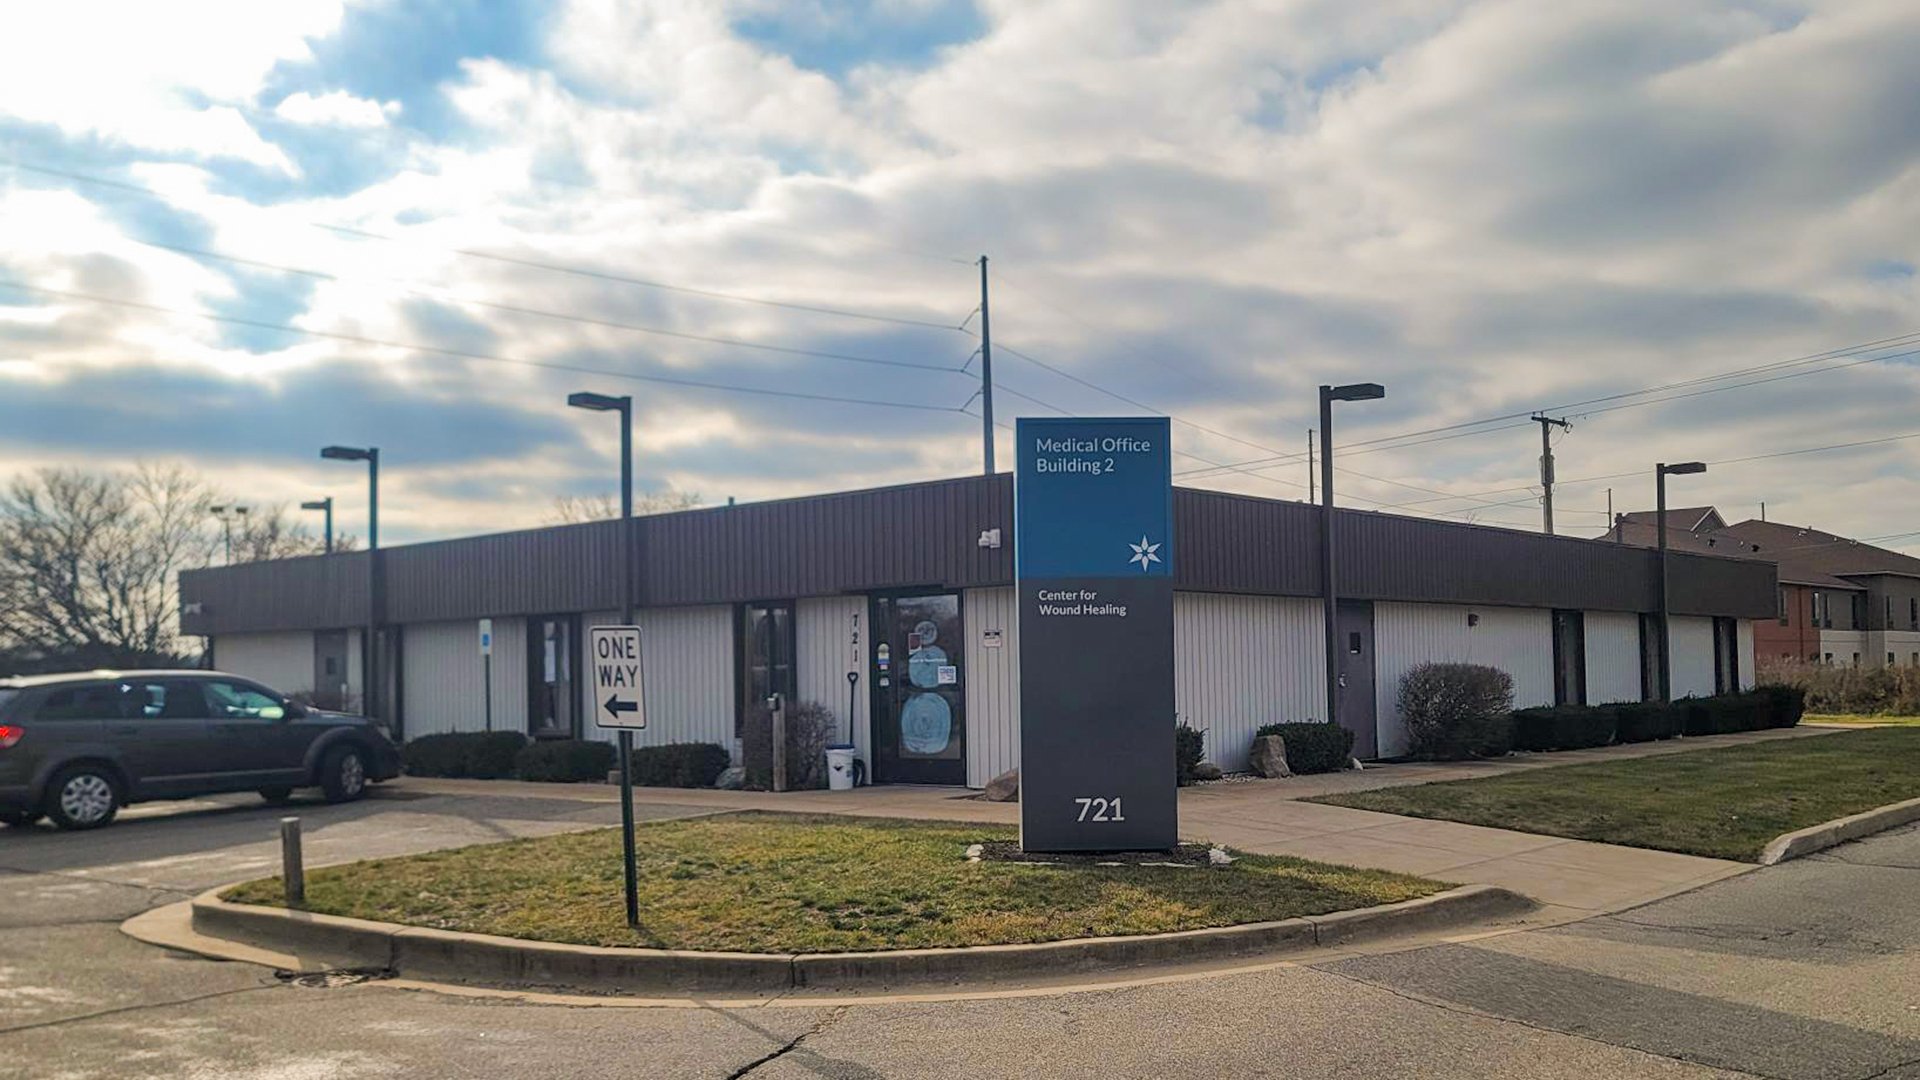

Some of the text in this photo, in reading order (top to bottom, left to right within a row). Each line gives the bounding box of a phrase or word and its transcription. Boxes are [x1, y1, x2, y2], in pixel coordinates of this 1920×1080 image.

[1036, 437, 1151, 453] Medical Office
[1037, 457, 1115, 475] Building 2
[1038, 589, 1097, 601] Center for
[1039, 603, 1127, 617] Wound Healing
[598, 636, 637, 659] ONE
[599, 665, 638, 687] WAY
[1075, 797, 1125, 822] 721
